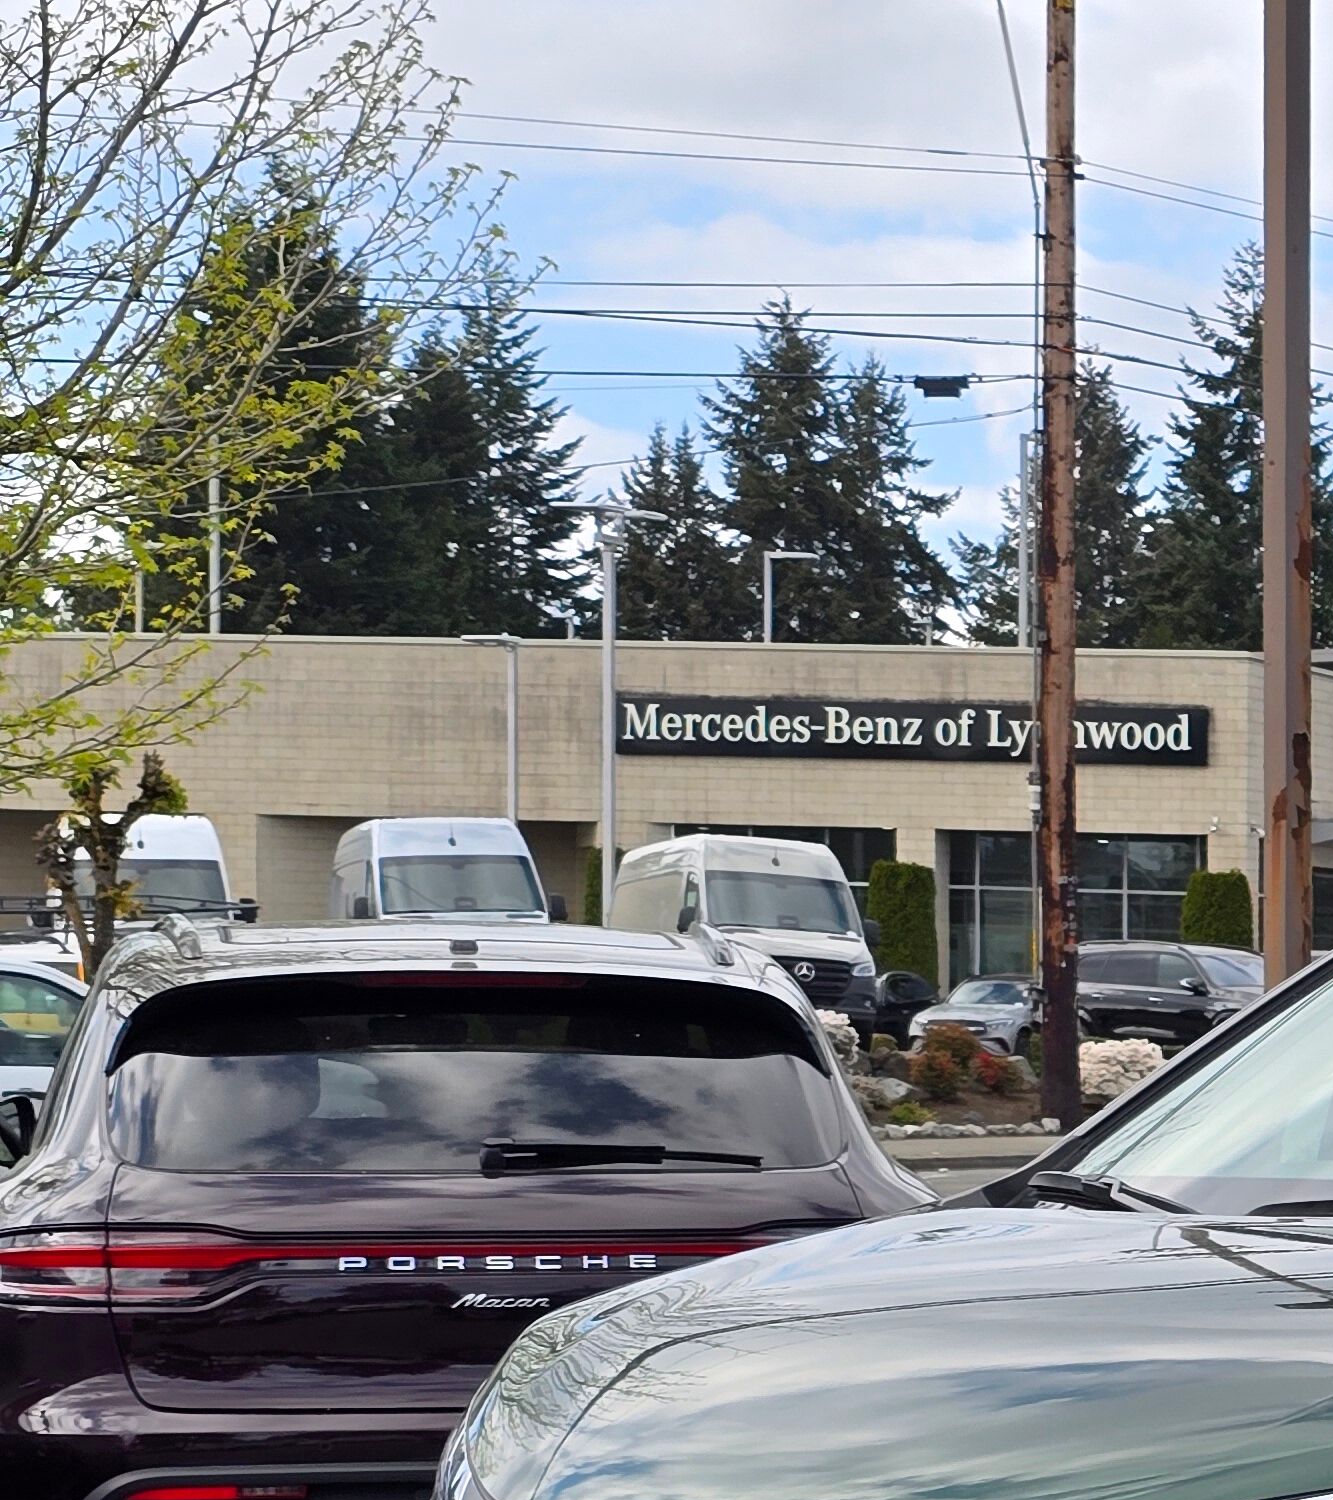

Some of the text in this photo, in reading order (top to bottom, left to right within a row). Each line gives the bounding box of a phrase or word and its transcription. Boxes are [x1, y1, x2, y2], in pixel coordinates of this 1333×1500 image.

[621, 702, 1192, 758] Mercedes-Benz of Lywood
[338, 1254, 658, 1271] PORSCHE
[449, 1292, 551, 1309] Macan
